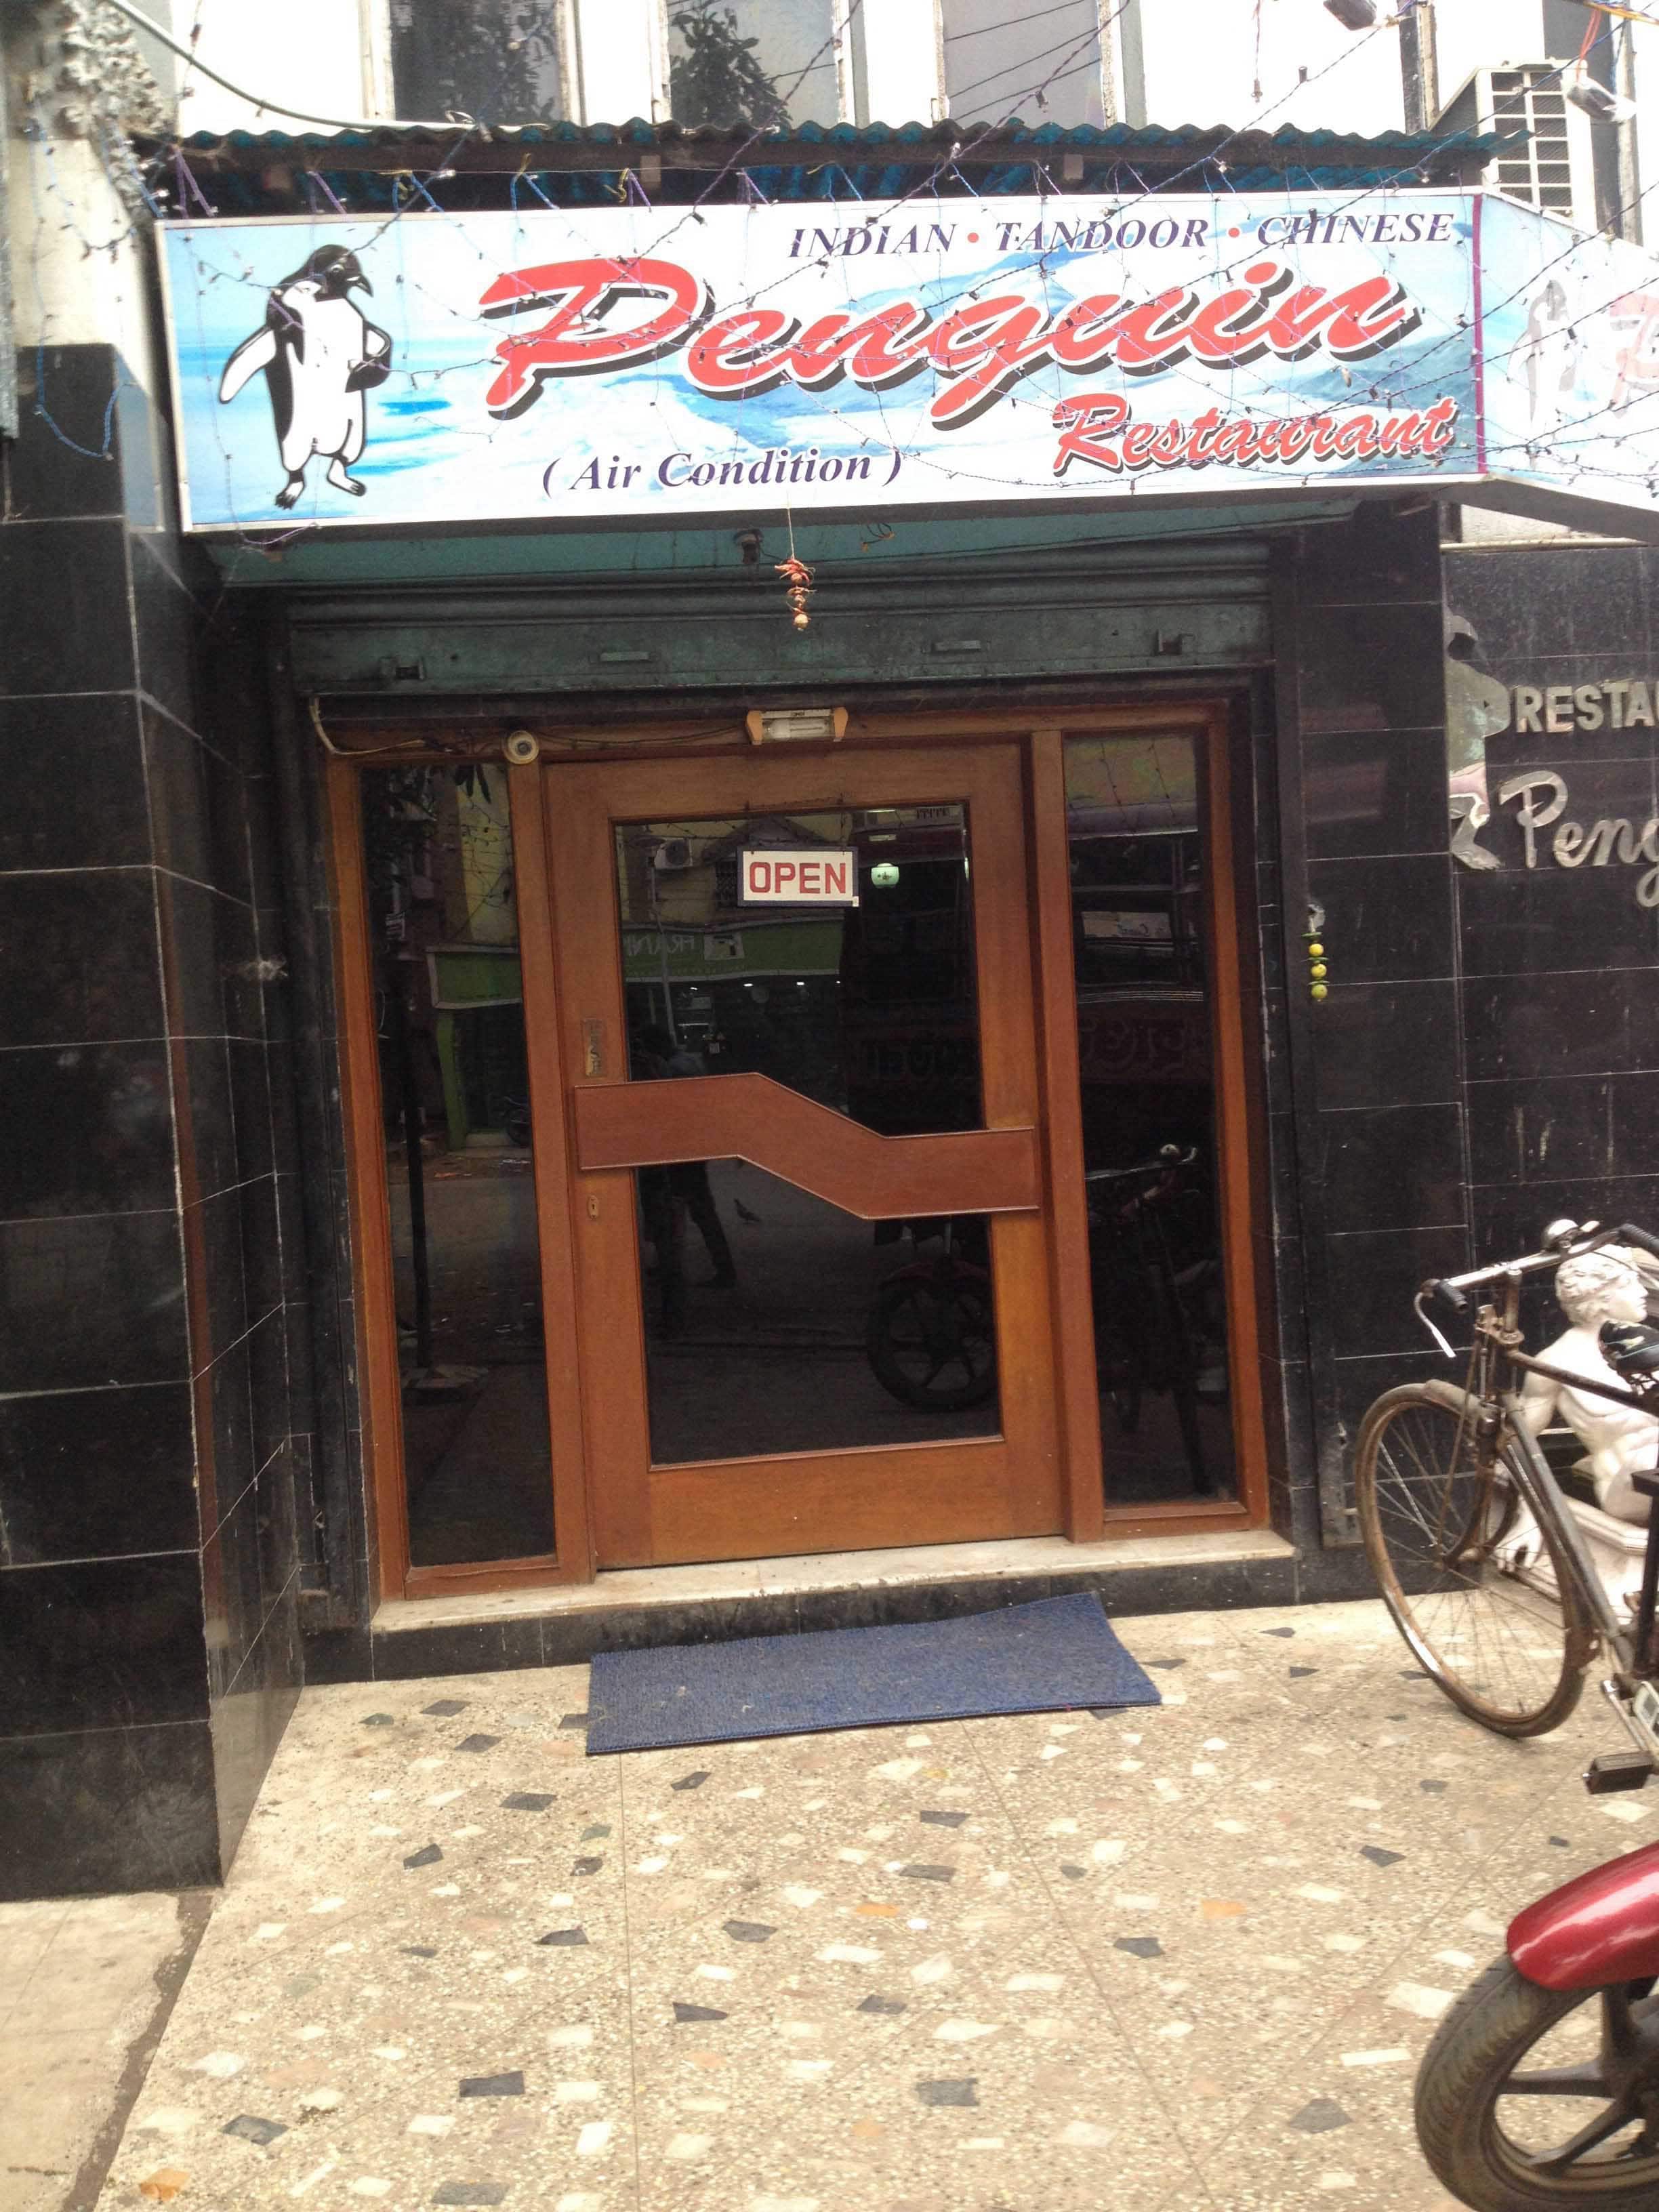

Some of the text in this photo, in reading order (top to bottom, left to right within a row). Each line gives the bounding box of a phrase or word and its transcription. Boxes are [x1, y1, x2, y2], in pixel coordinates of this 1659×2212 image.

[789, 213, 1455, 258] INDIAN TANDOOR CHINESE
[478, 257, 1421, 430] Penguin
[1052, 392, 1460, 477] Restaurant
[568, 454, 642, 491] Air
[658, 448, 873, 488] Condition
[1515, 680, 1659, 733] RESTA
[749, 861, 846, 894] OPEN
